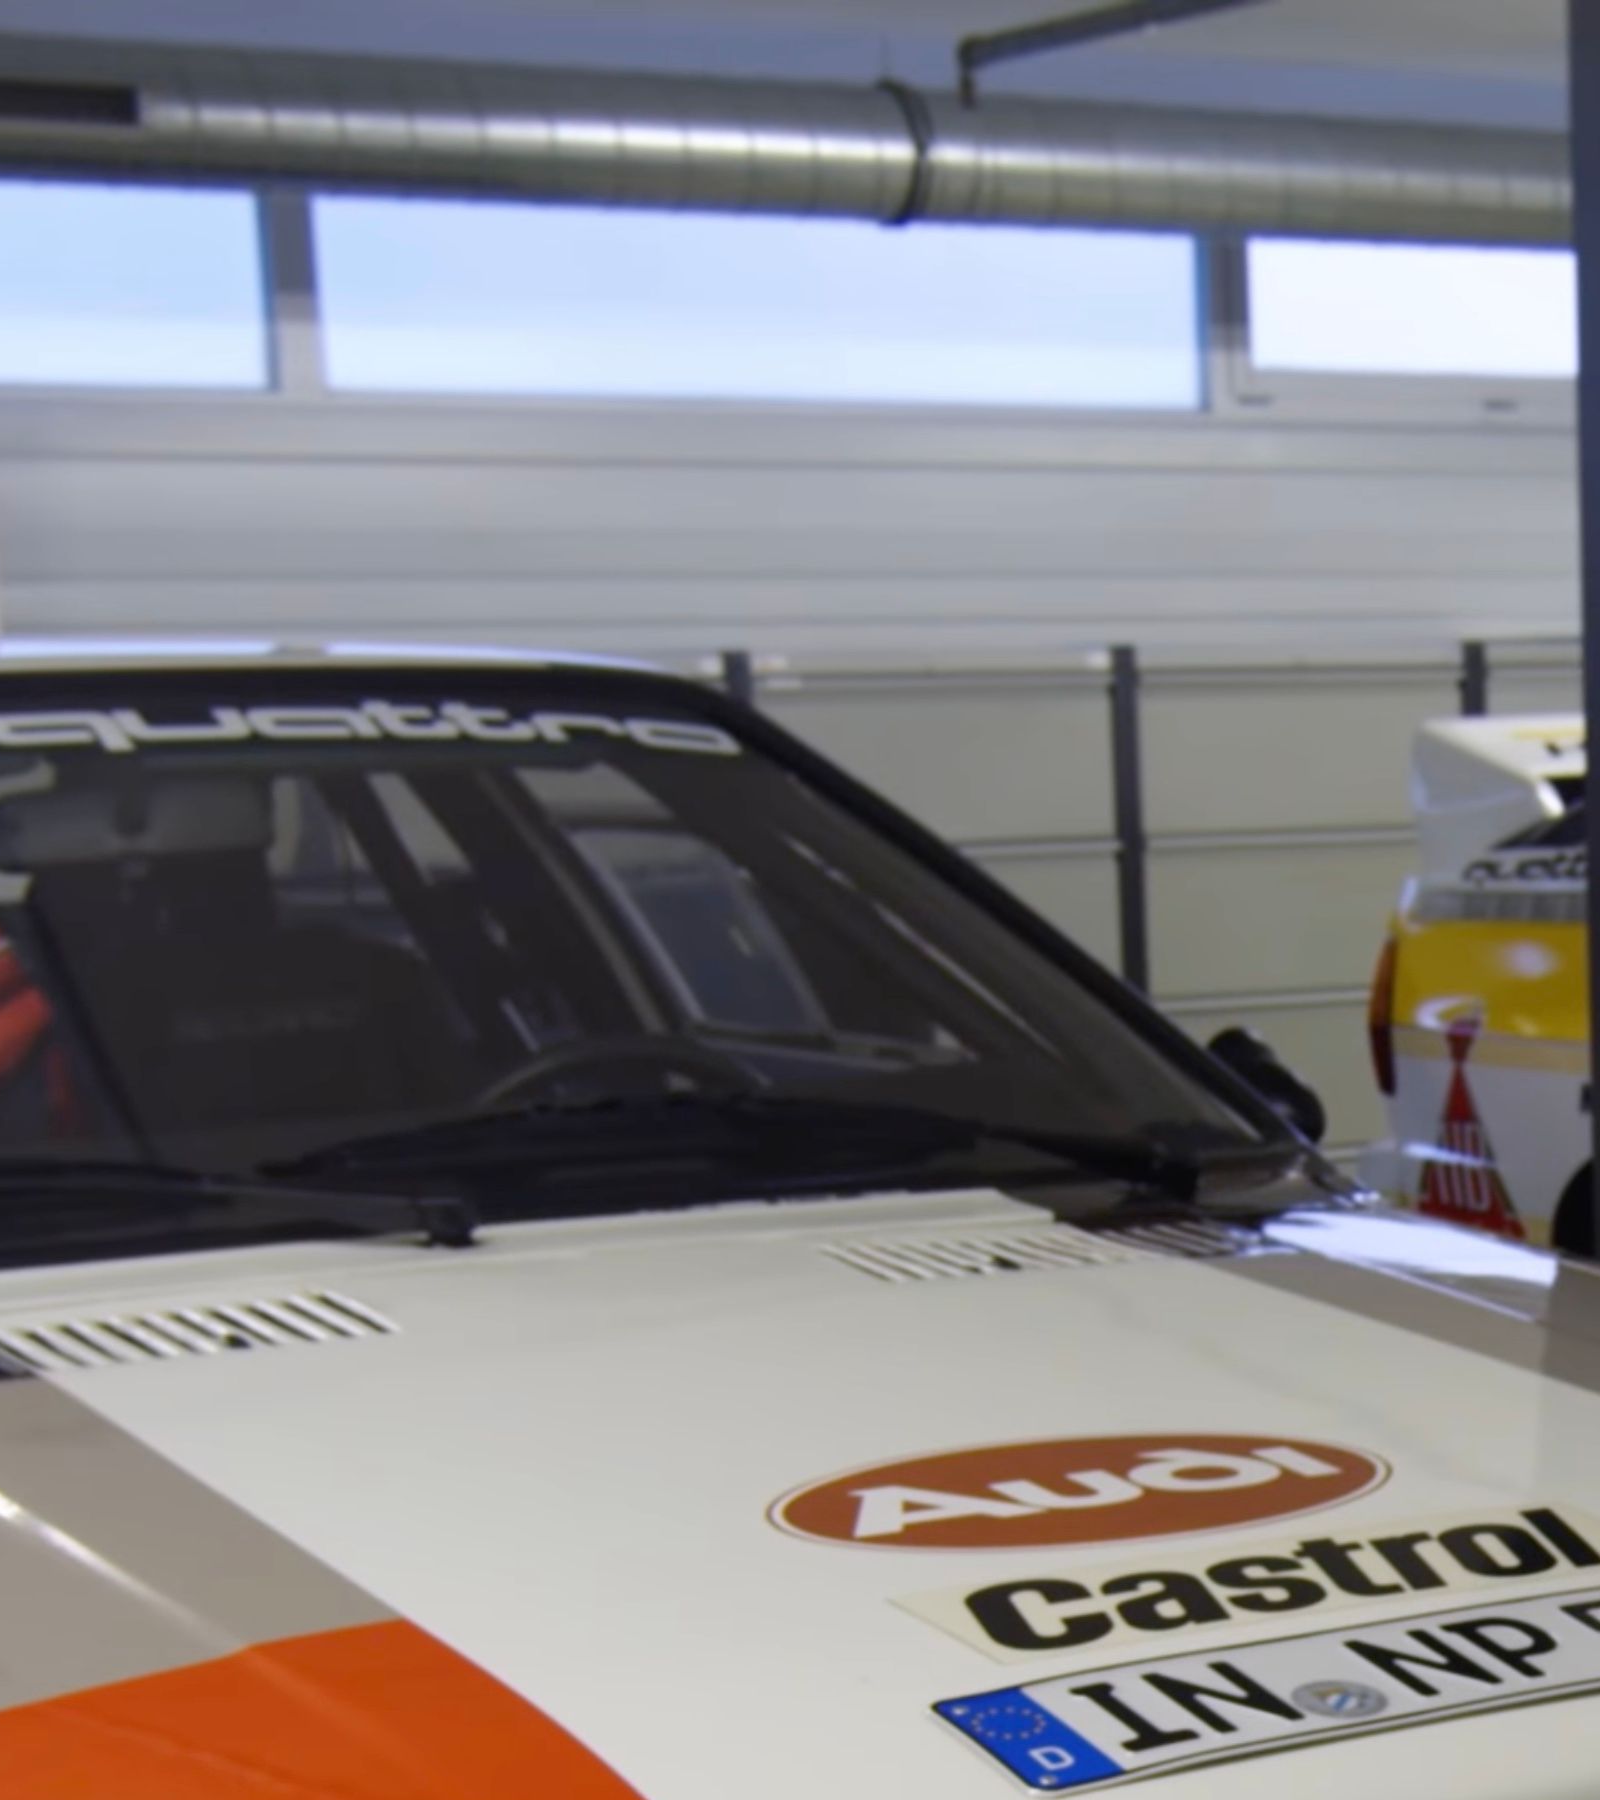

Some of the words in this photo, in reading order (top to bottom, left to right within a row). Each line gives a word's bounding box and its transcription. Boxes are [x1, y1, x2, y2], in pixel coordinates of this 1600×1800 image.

[849, 1444, 1343, 1539] Audi
[1069, 1660, 1306, 1753] IN
[1344, 1614, 1558, 1697] NP
[1027, 1745, 1076, 1771] D
